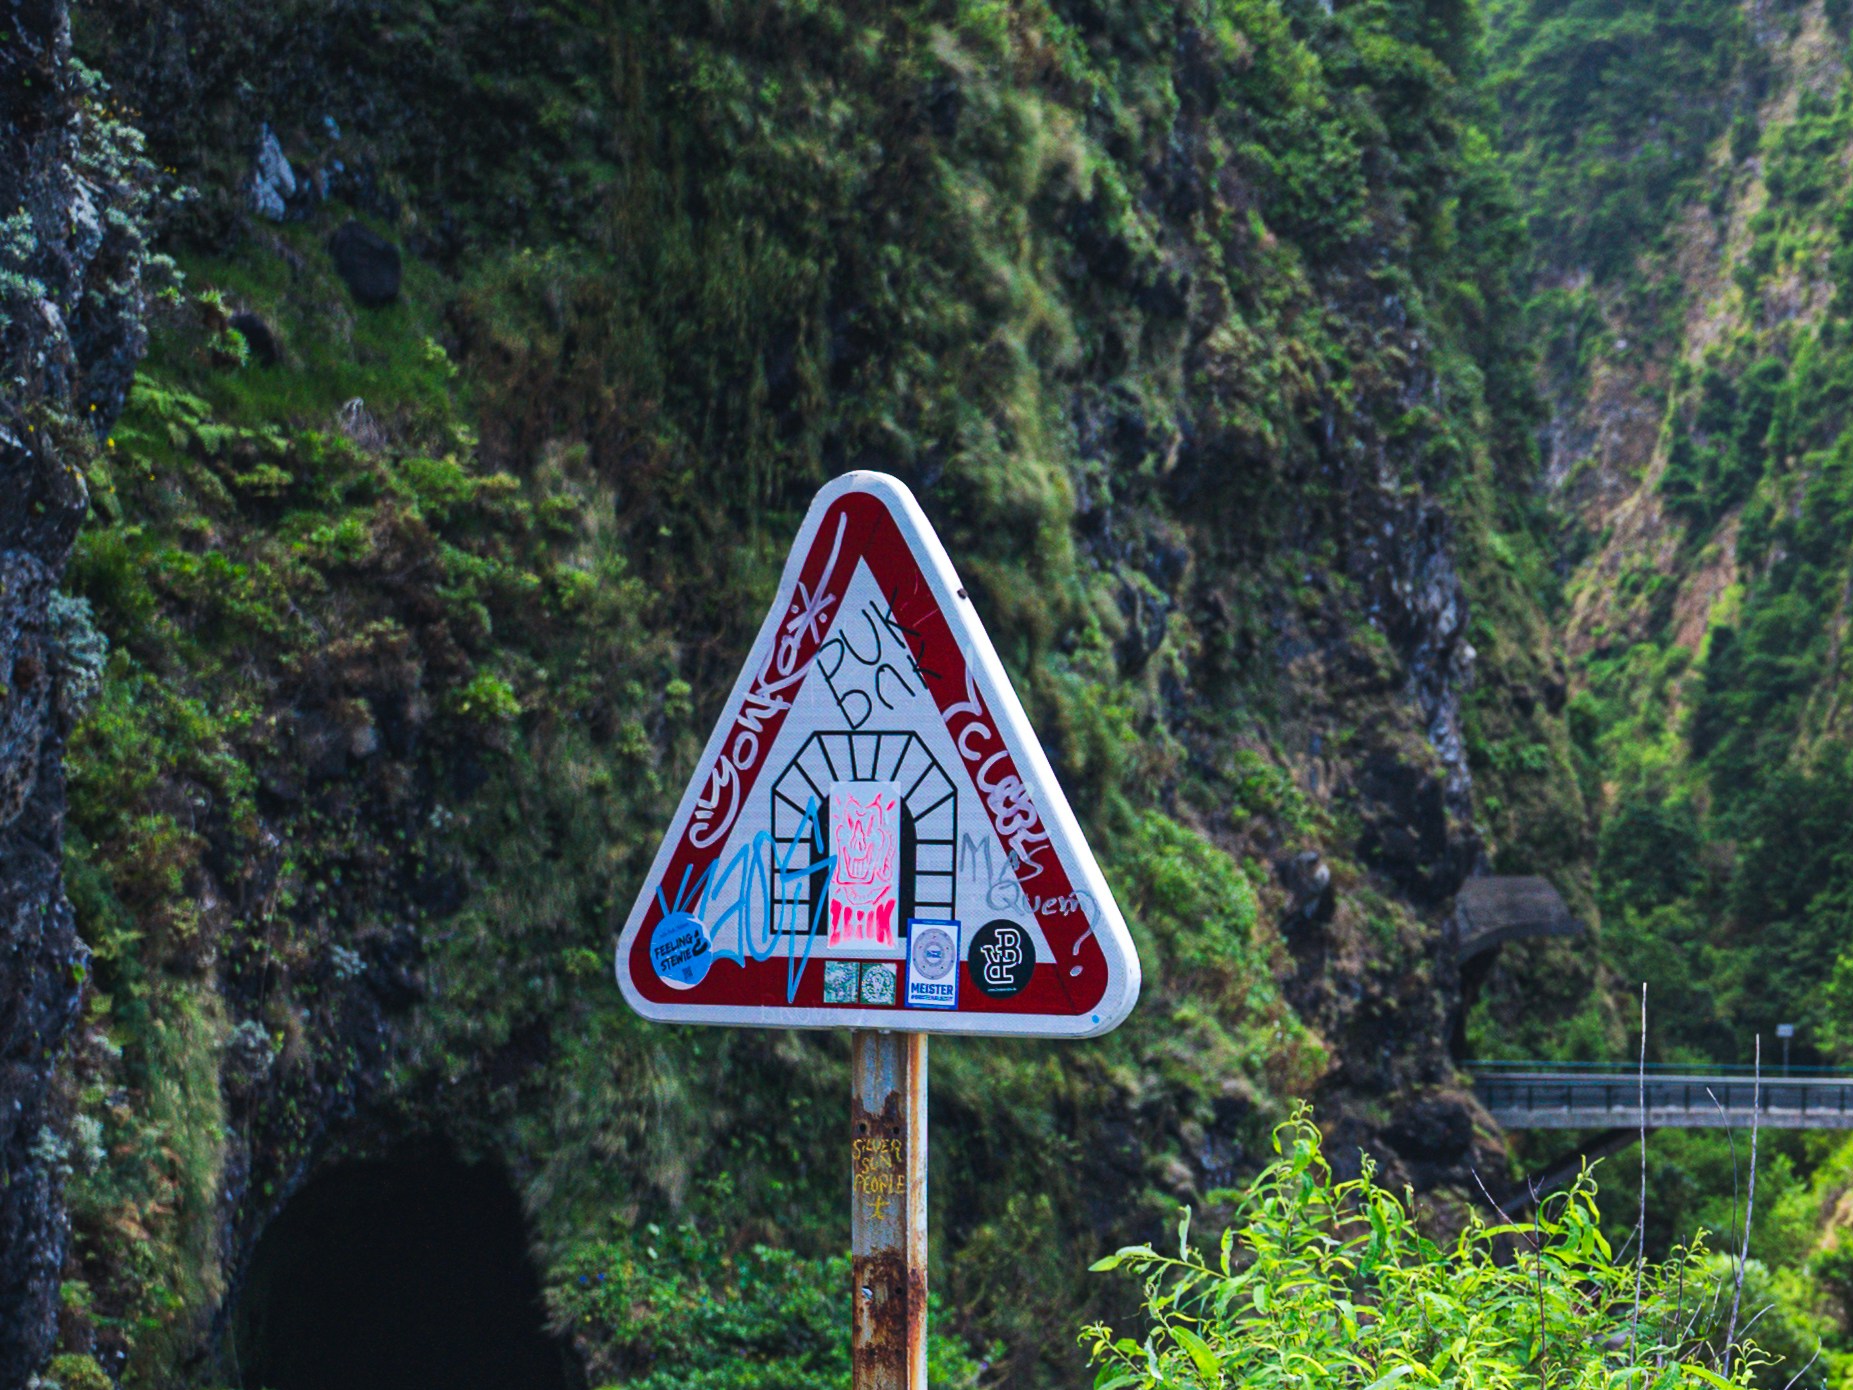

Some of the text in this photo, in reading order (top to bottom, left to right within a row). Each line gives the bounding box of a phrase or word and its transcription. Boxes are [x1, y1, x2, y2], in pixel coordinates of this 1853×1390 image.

[654, 933, 693, 960] FEELING
[660, 947, 693, 972] STEWIE
[910, 982, 954, 996] MEISTER
[861, 1155, 893, 1174] SUN
